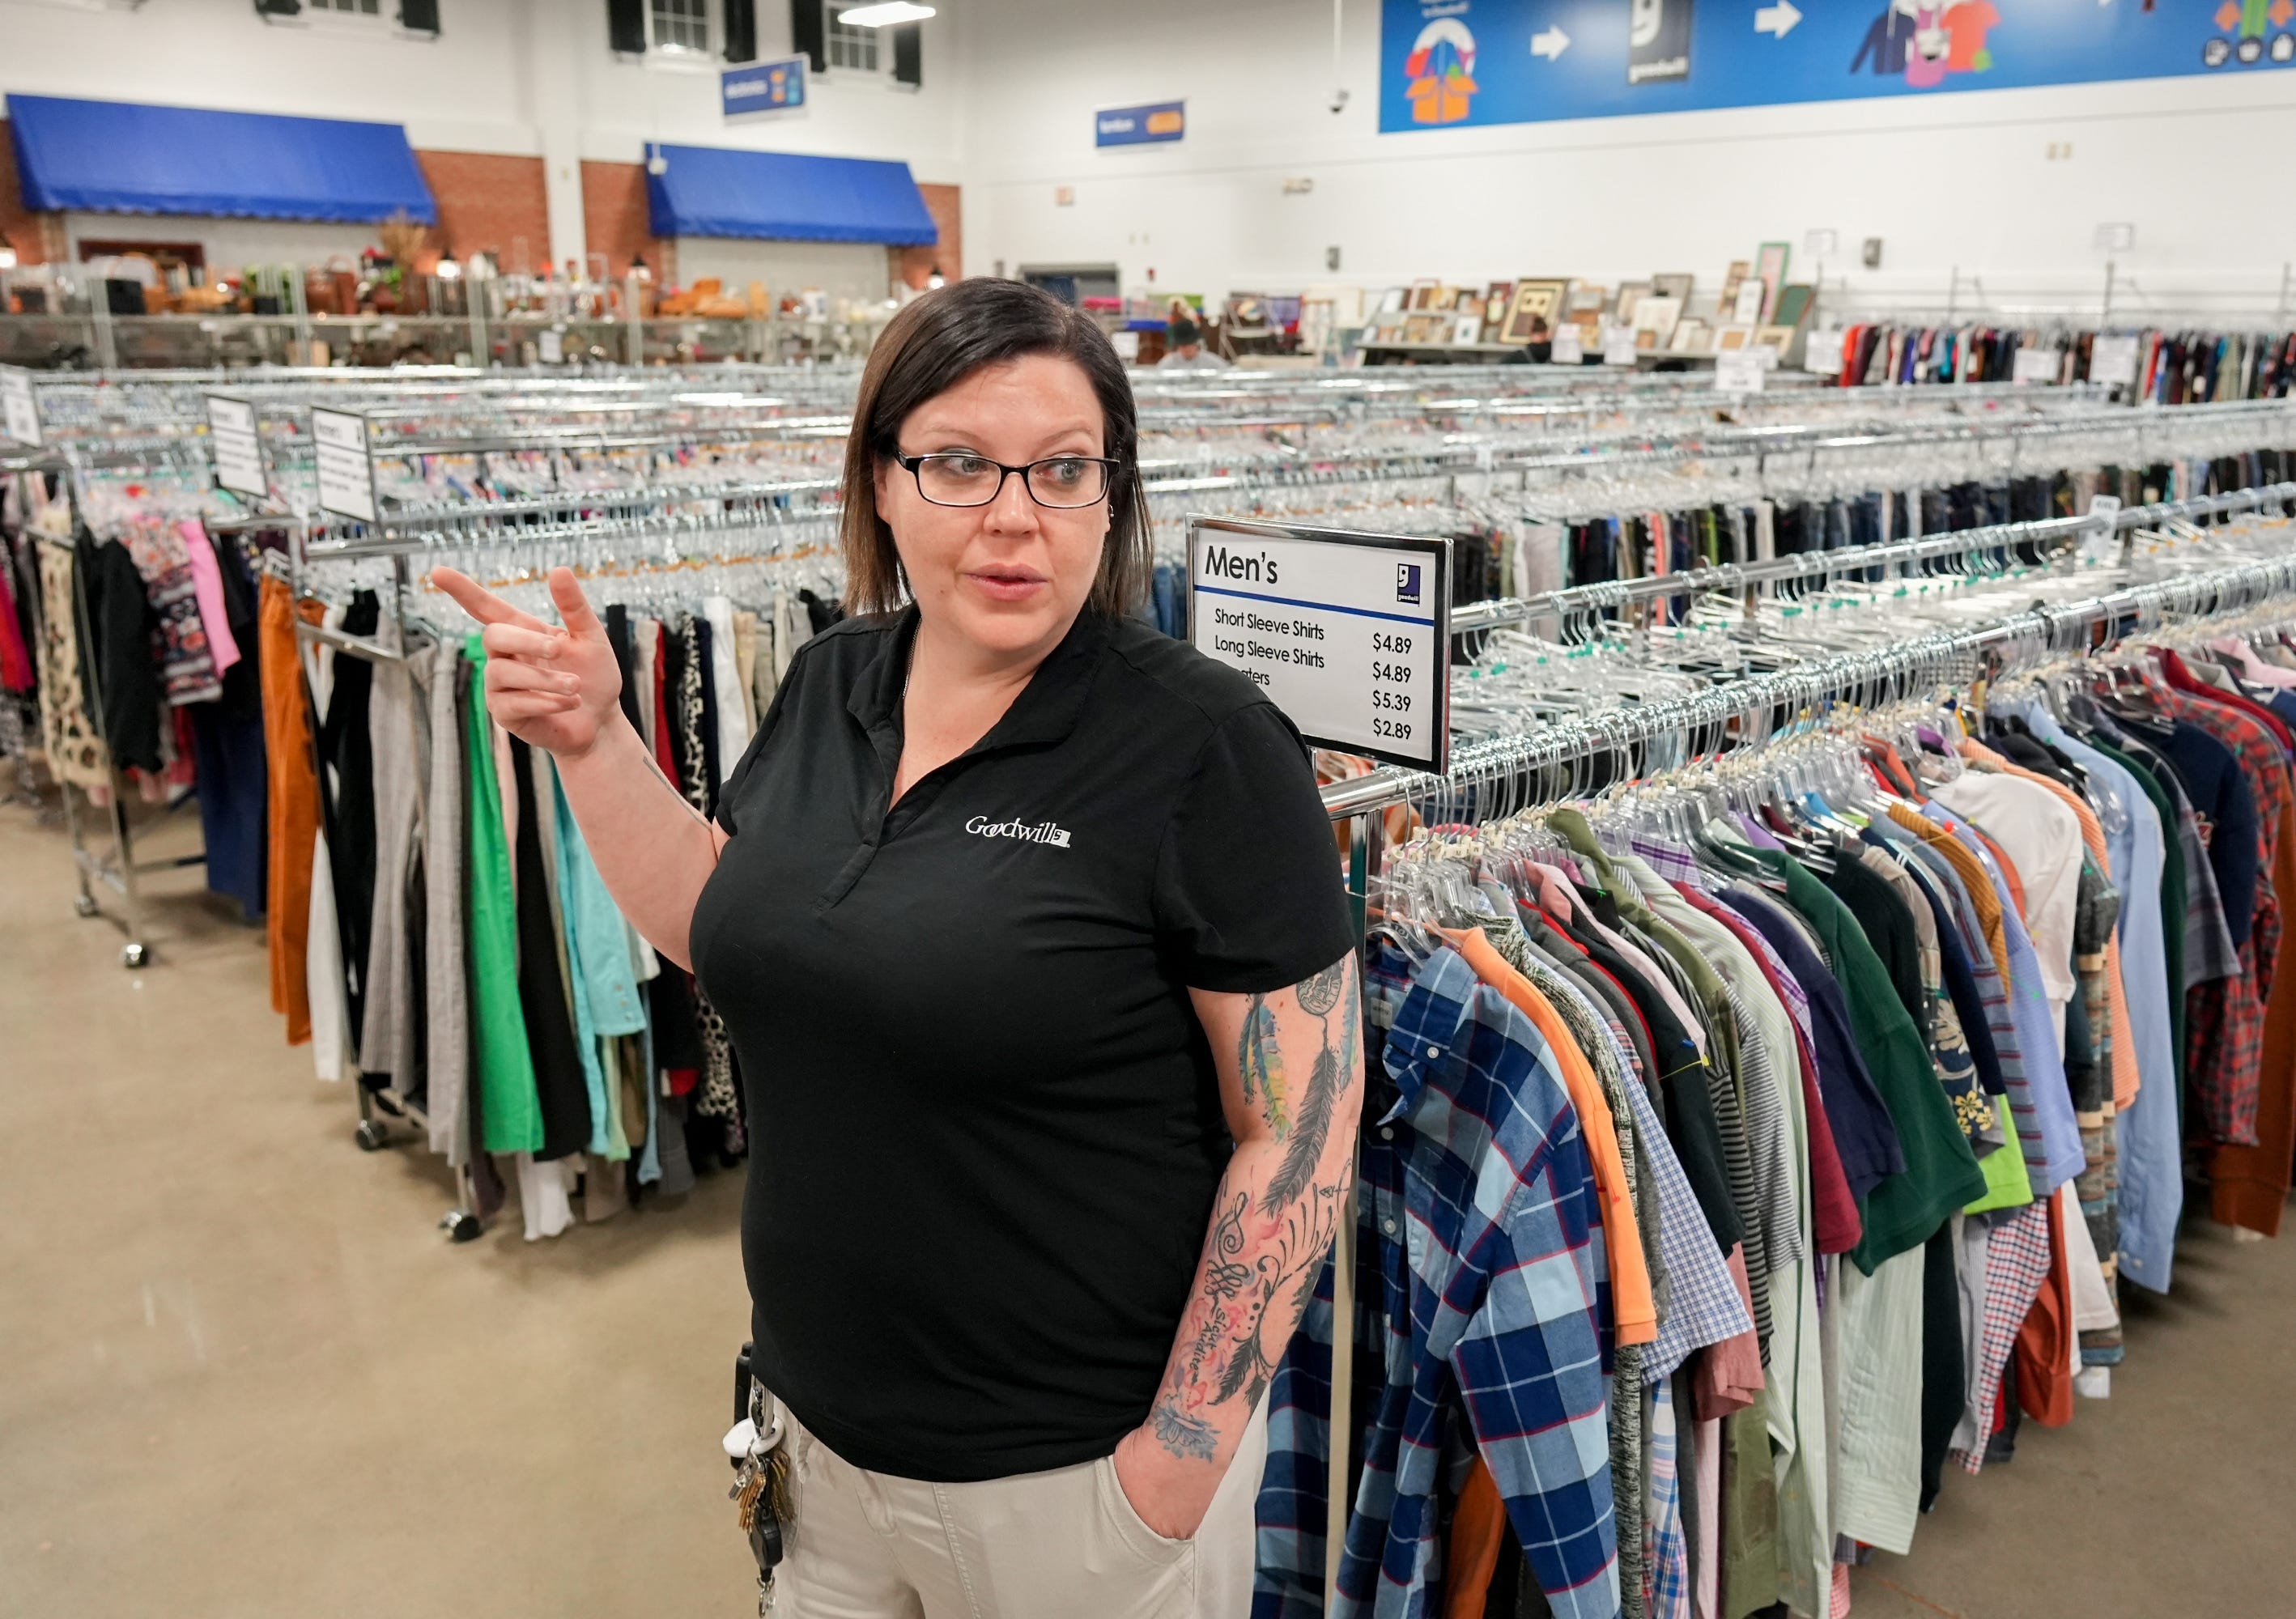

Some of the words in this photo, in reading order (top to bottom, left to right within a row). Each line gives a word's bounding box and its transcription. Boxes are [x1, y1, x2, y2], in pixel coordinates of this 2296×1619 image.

[1205, 546, 1278, 584] Men's
[1214, 609, 1244, 627] Short
[1247, 614, 1290, 634] Sleeve
[1293, 620, 1324, 640] Shirts
[1373, 632, 1412, 654] $4.89
[1215, 635, 1244, 657] Long
[1248, 641, 1290, 662] Sleeve
[1293, 648, 1324, 668] Shirts
[1372, 661, 1411, 682] $4.89
[1372, 690, 1411, 712] $5.39
[1373, 717, 1412, 739] $2.89
[965, 815, 1057, 843] Goodwill
